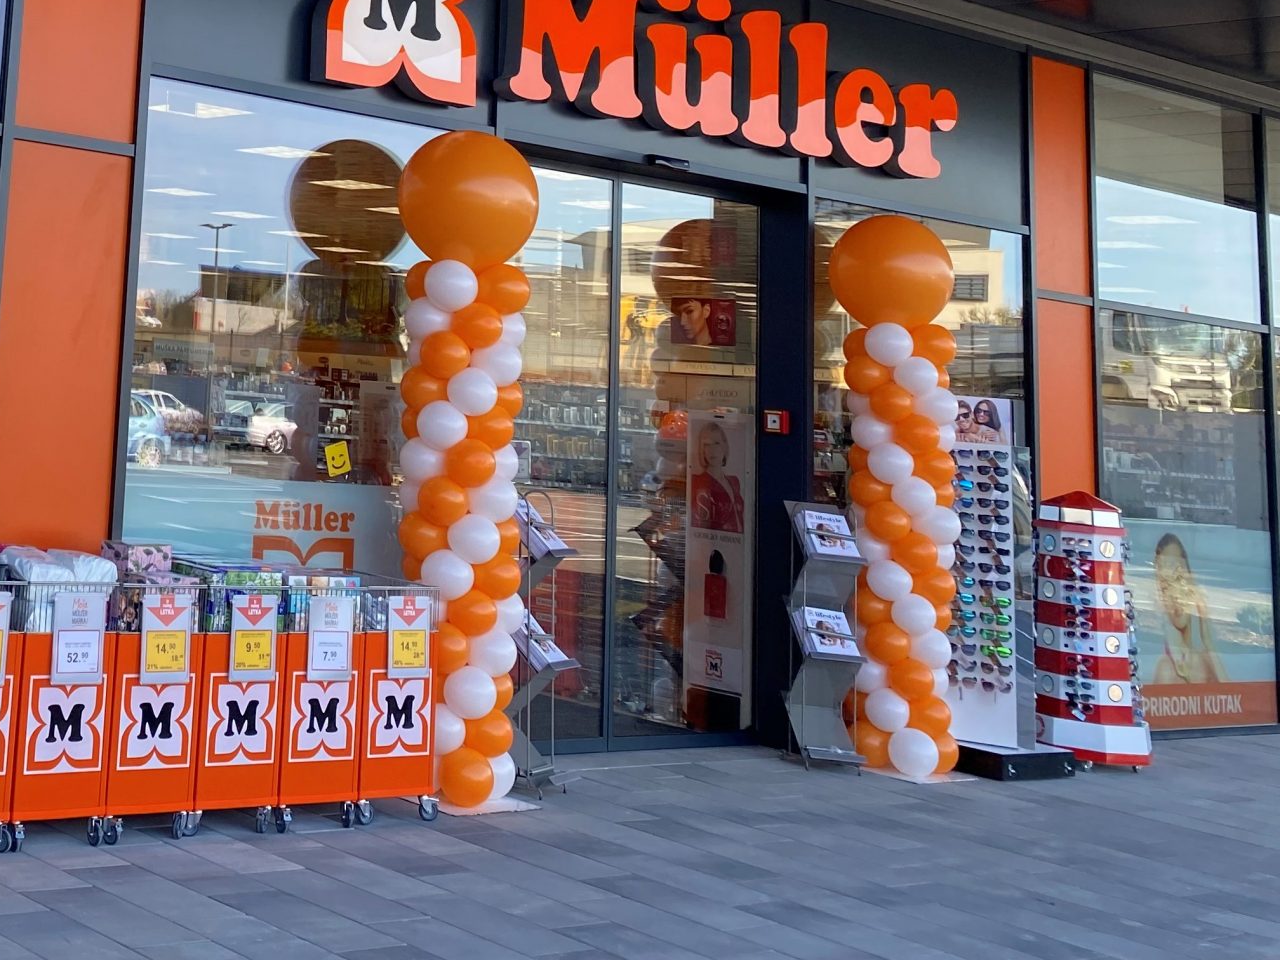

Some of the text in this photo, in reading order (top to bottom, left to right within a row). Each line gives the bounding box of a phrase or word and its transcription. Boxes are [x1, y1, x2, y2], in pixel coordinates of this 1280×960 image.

[254, 499, 356, 532] Müller
[45, 703, 85, 743] M
[137, 701, 176, 739] M
[224, 700, 259, 737] M
[306, 698, 340, 733] M
[383, 695, 415, 730] M
[1142, 694, 1243, 717] PRIRODNI KUTAK
